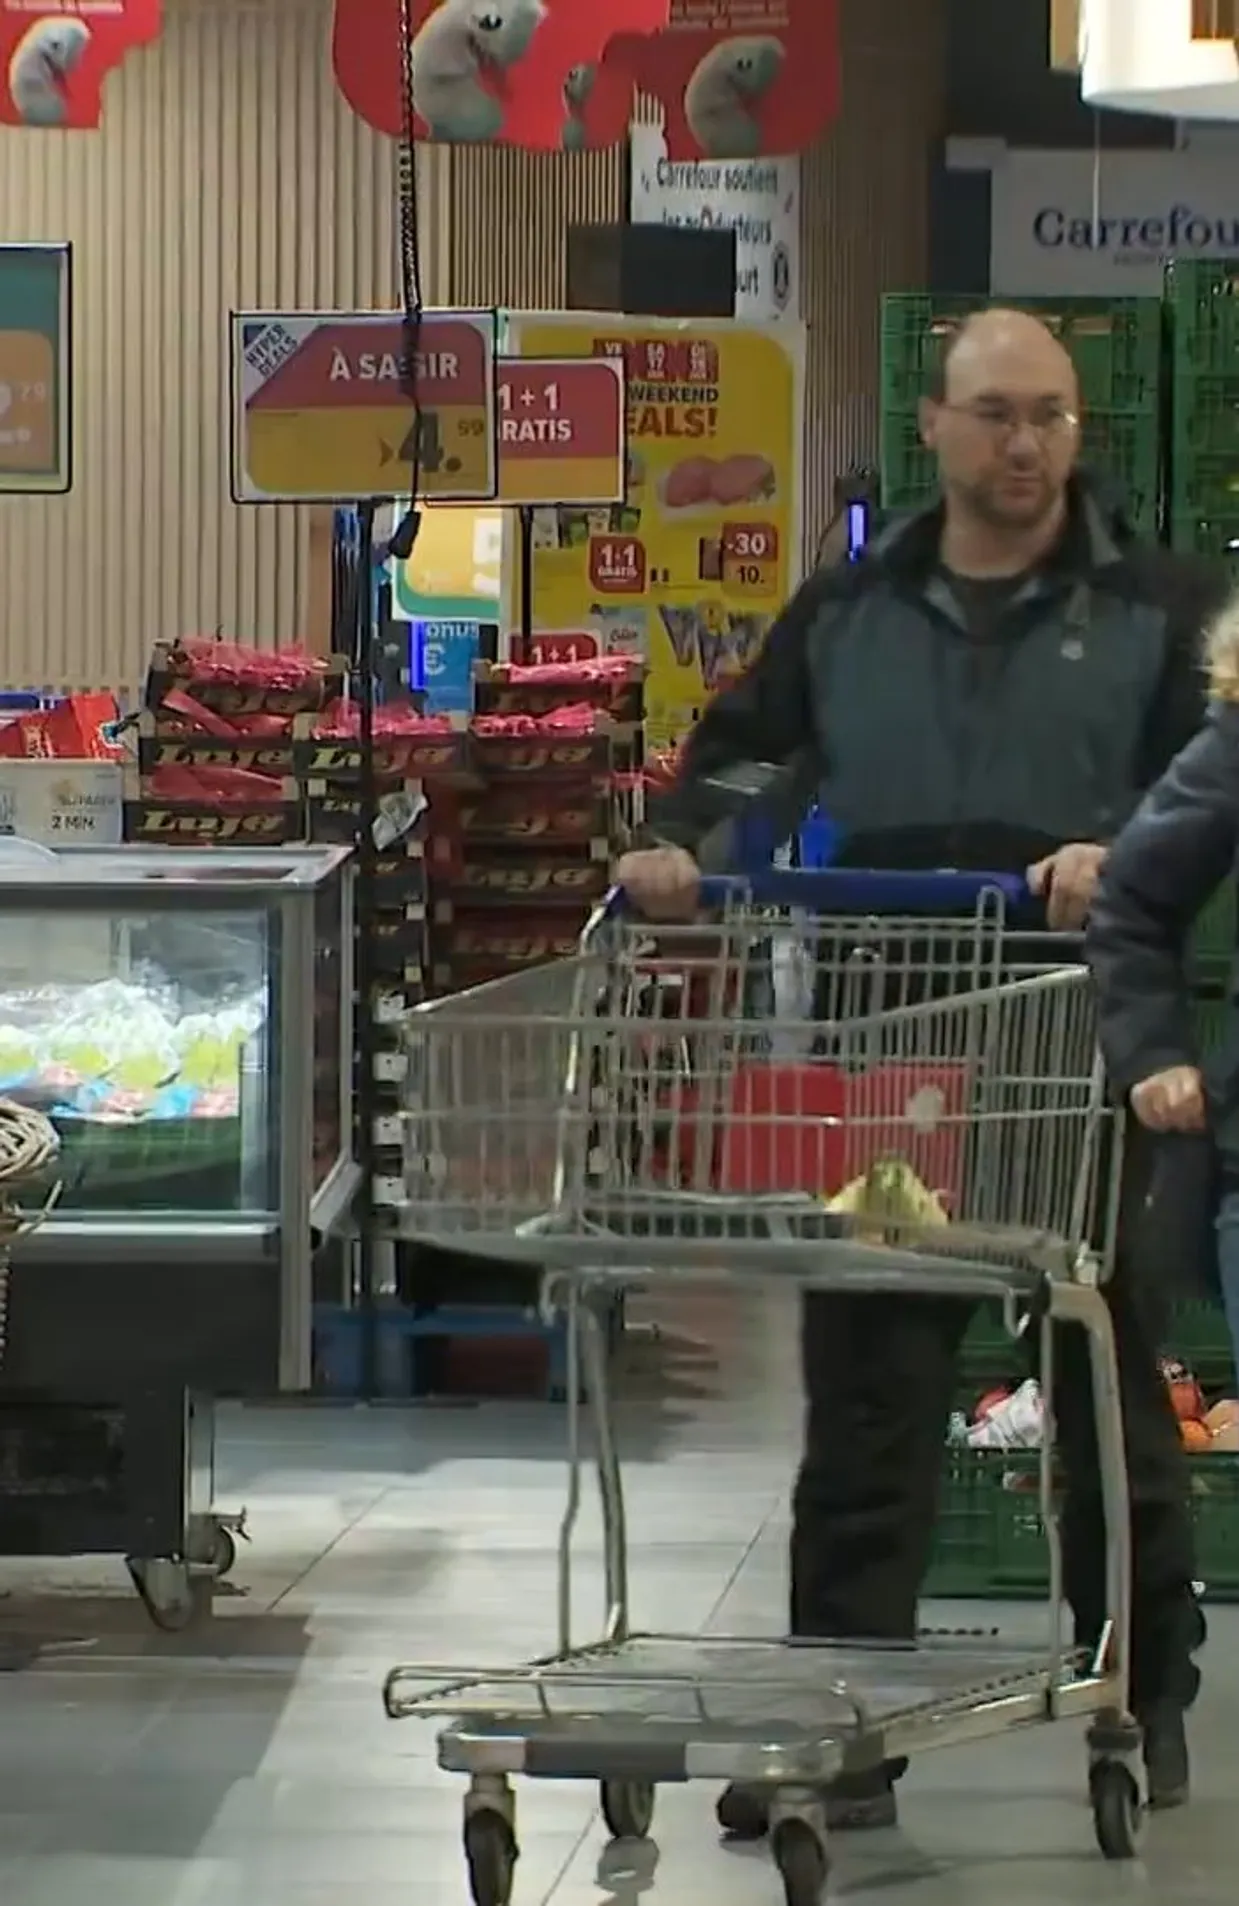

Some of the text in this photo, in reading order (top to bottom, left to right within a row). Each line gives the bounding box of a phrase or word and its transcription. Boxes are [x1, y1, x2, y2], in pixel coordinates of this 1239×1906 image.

[329, 346, 351, 381] À
[629, 385, 719, 402] WEEKEND
[499, 419, 572, 441] RATIS
